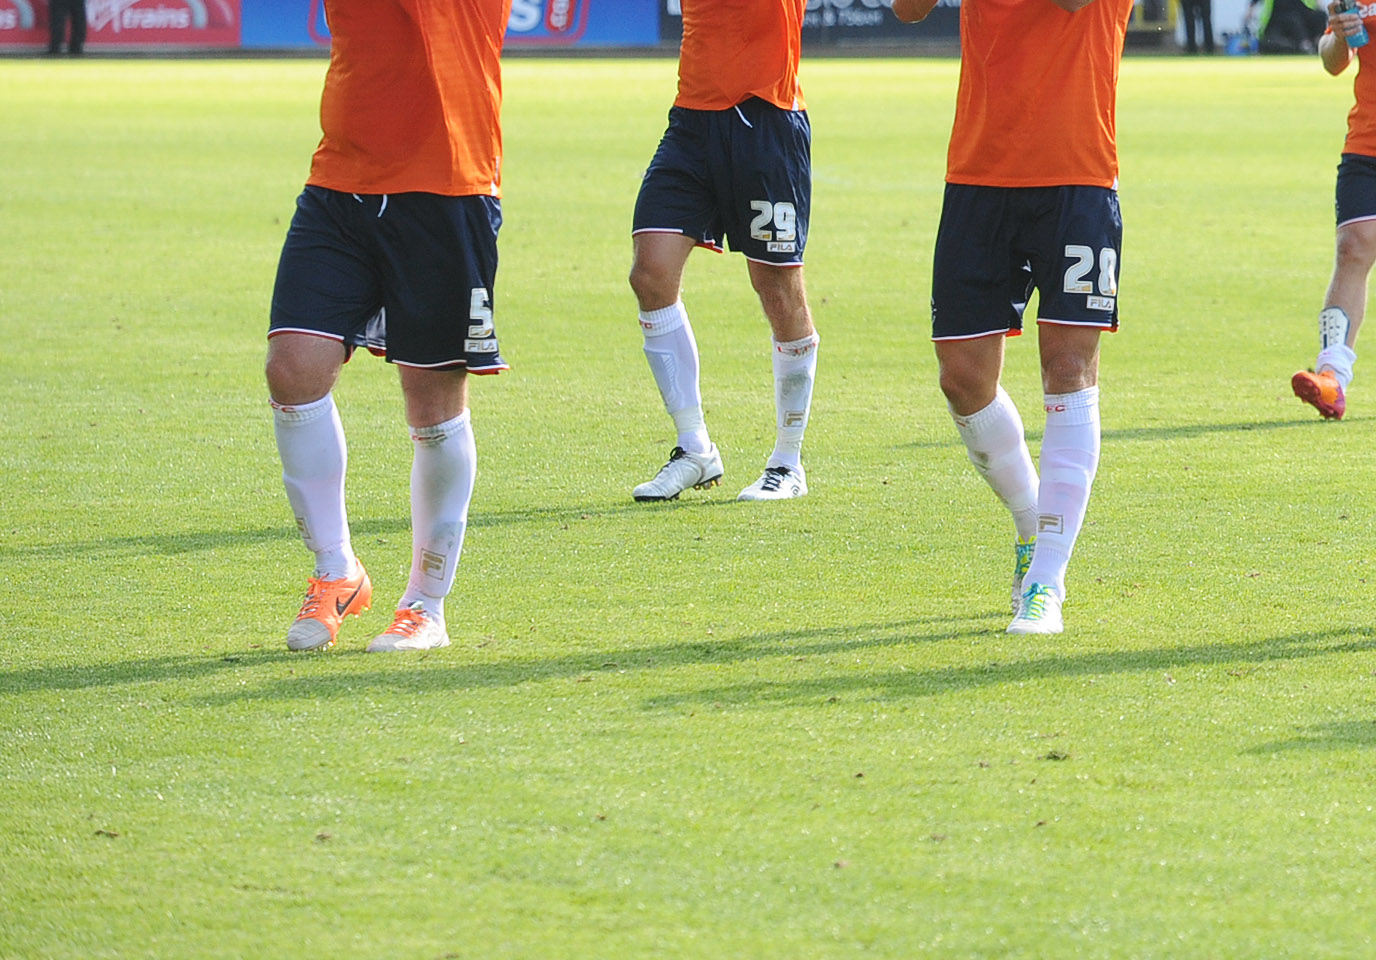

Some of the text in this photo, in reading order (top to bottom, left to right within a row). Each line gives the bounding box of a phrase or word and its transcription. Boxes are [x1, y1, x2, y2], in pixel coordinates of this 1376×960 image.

[122, 4, 191, 29] trains
[750, 200, 796, 241] 29
[770, 243, 793, 251] FILA
[1063, 244, 1117, 297] 28
[467, 287, 494, 338] 5
[1090, 299, 1112, 309] FILA
[468, 342, 494, 351] FILA
